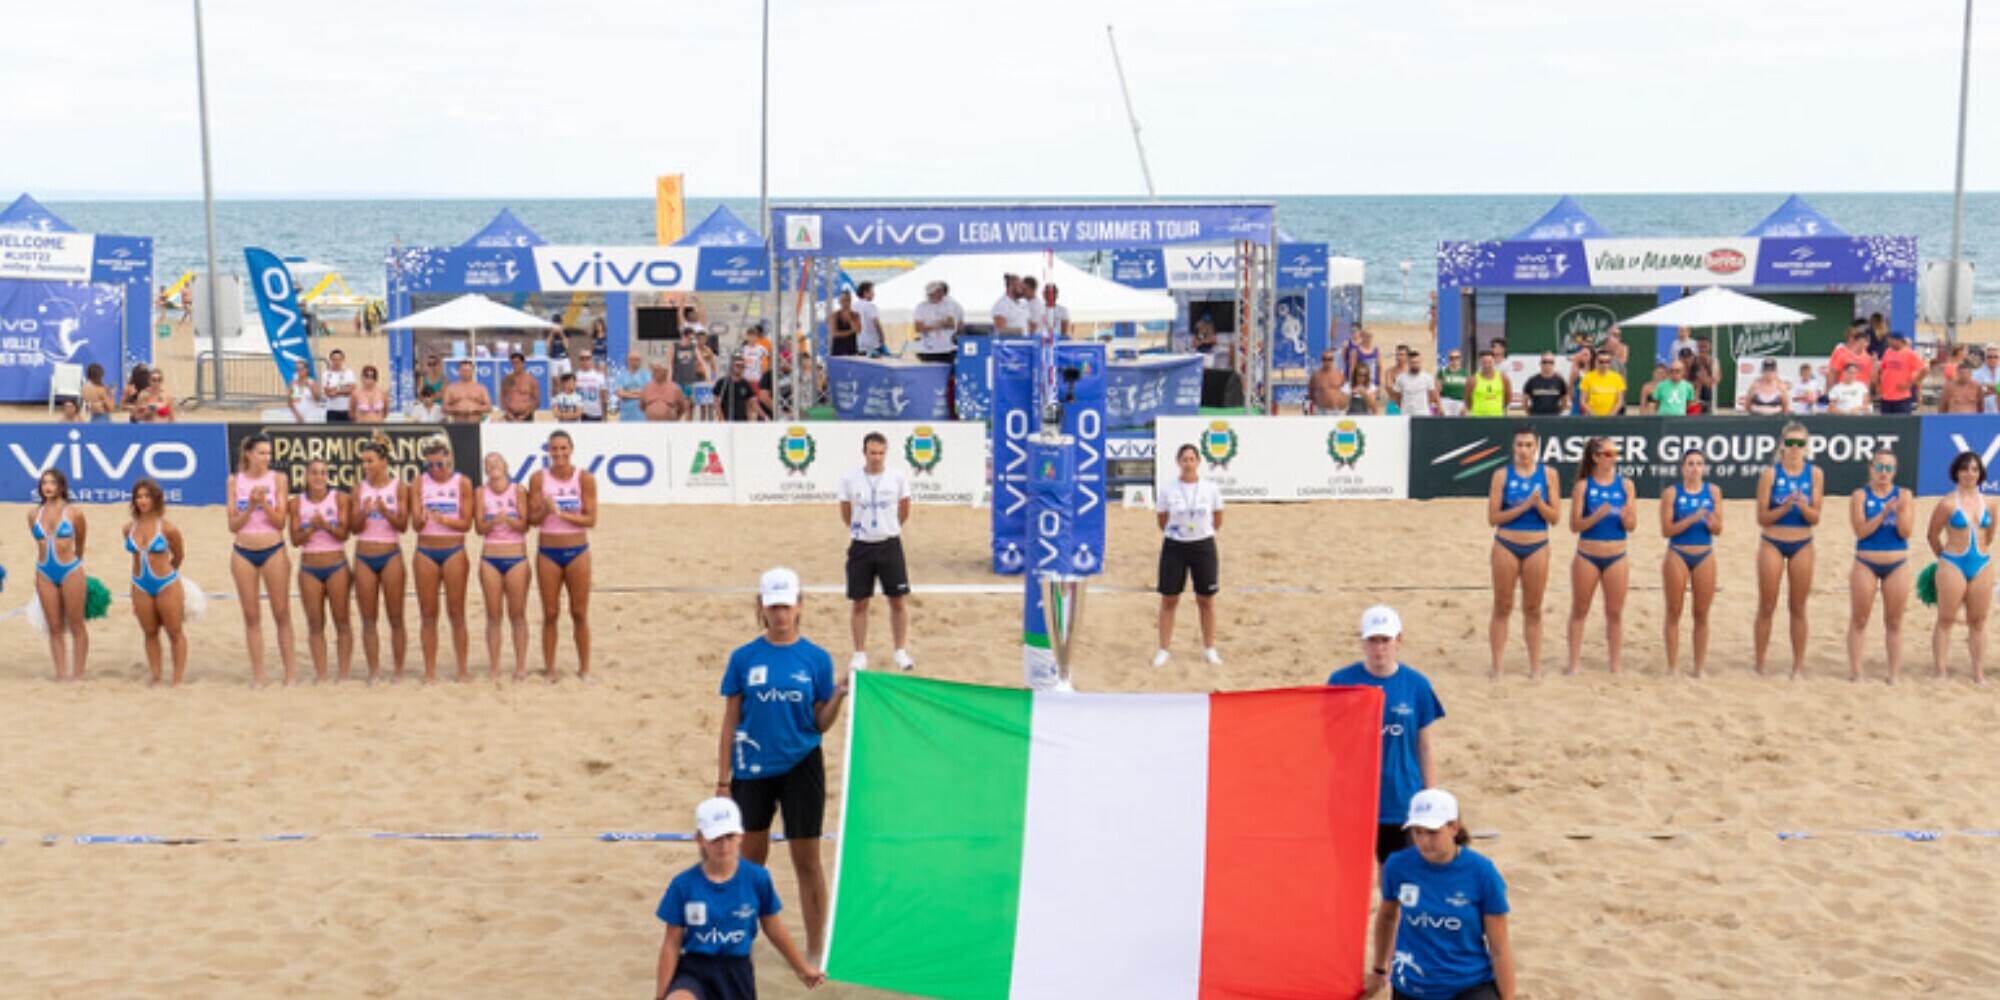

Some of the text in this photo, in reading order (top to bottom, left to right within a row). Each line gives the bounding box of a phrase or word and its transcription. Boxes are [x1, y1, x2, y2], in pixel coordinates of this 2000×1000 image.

[0, 234, 66, 250] ELCOME
[844, 217, 945, 246] vivo
[958, 222, 1002, 243] LEGA
[1005, 221, 1071, 243] VOLLEY
[1075, 220, 1151, 242] SUMMER
[1155, 219, 1200, 240] TOUR
[552, 251, 683, 287] vivo
[0, 318, 38, 333] vo
[8, 428, 197, 480] vivo
[274, 437, 433, 462] PARMIGANO
[1535, 435, 1899, 462] ASER GROUP PORT
[509, 443, 655, 487] vio
[998, 409, 1028, 516] vivo
[1072, 409, 1101, 516] vivo
[1617, 465, 1646, 477] JOY
[1651, 465, 1677, 477] THE
[1717, 465, 1736, 476] OF
[1740, 465, 1769, 477] SPO
[291, 464, 420, 488] RGGINO
[31, 488, 183, 502] SARTPHE
[1032, 509, 1060, 607] ivo
[757, 687, 803, 703] vivo
[1382, 723, 1405, 736] vo
[1406, 911, 1463, 931] vivo
[694, 927, 746, 944] vivo
